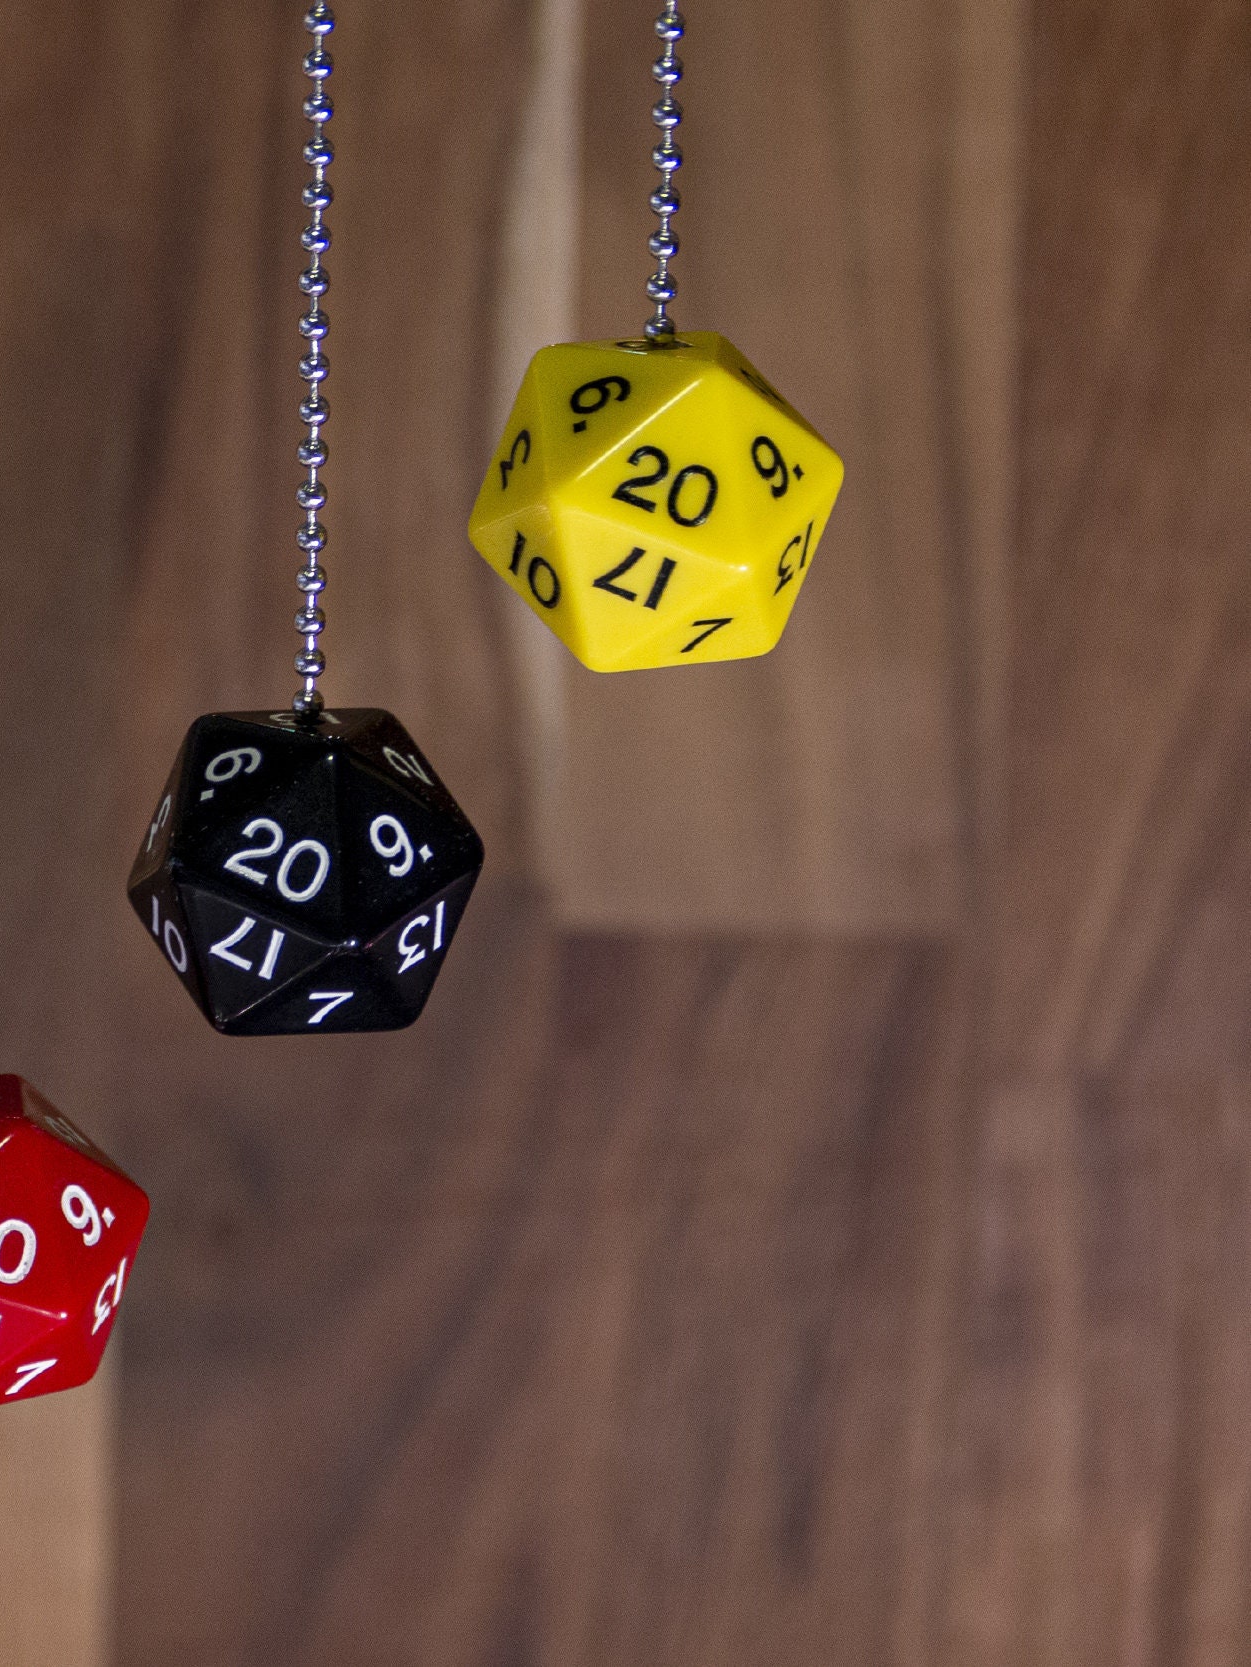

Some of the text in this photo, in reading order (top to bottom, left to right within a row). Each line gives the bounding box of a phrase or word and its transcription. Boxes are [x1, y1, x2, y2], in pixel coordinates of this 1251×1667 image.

[499, 429, 530, 490] 3
[611, 446, 718, 527] 20
[509, 531, 560, 609] 10
[593, 547, 677, 610] 17
[774, 520, 814, 596] 13
[681, 618, 733, 653] 7
[223, 817, 330, 902] 20
[152, 896, 186, 973] 10
[209, 917, 284, 980] 17
[398, 901, 445, 974] 13
[308, 991, 353, 1024] 7
[92, 1257, 126, 1336] 13
[5, 1359, 58, 1395] 7
